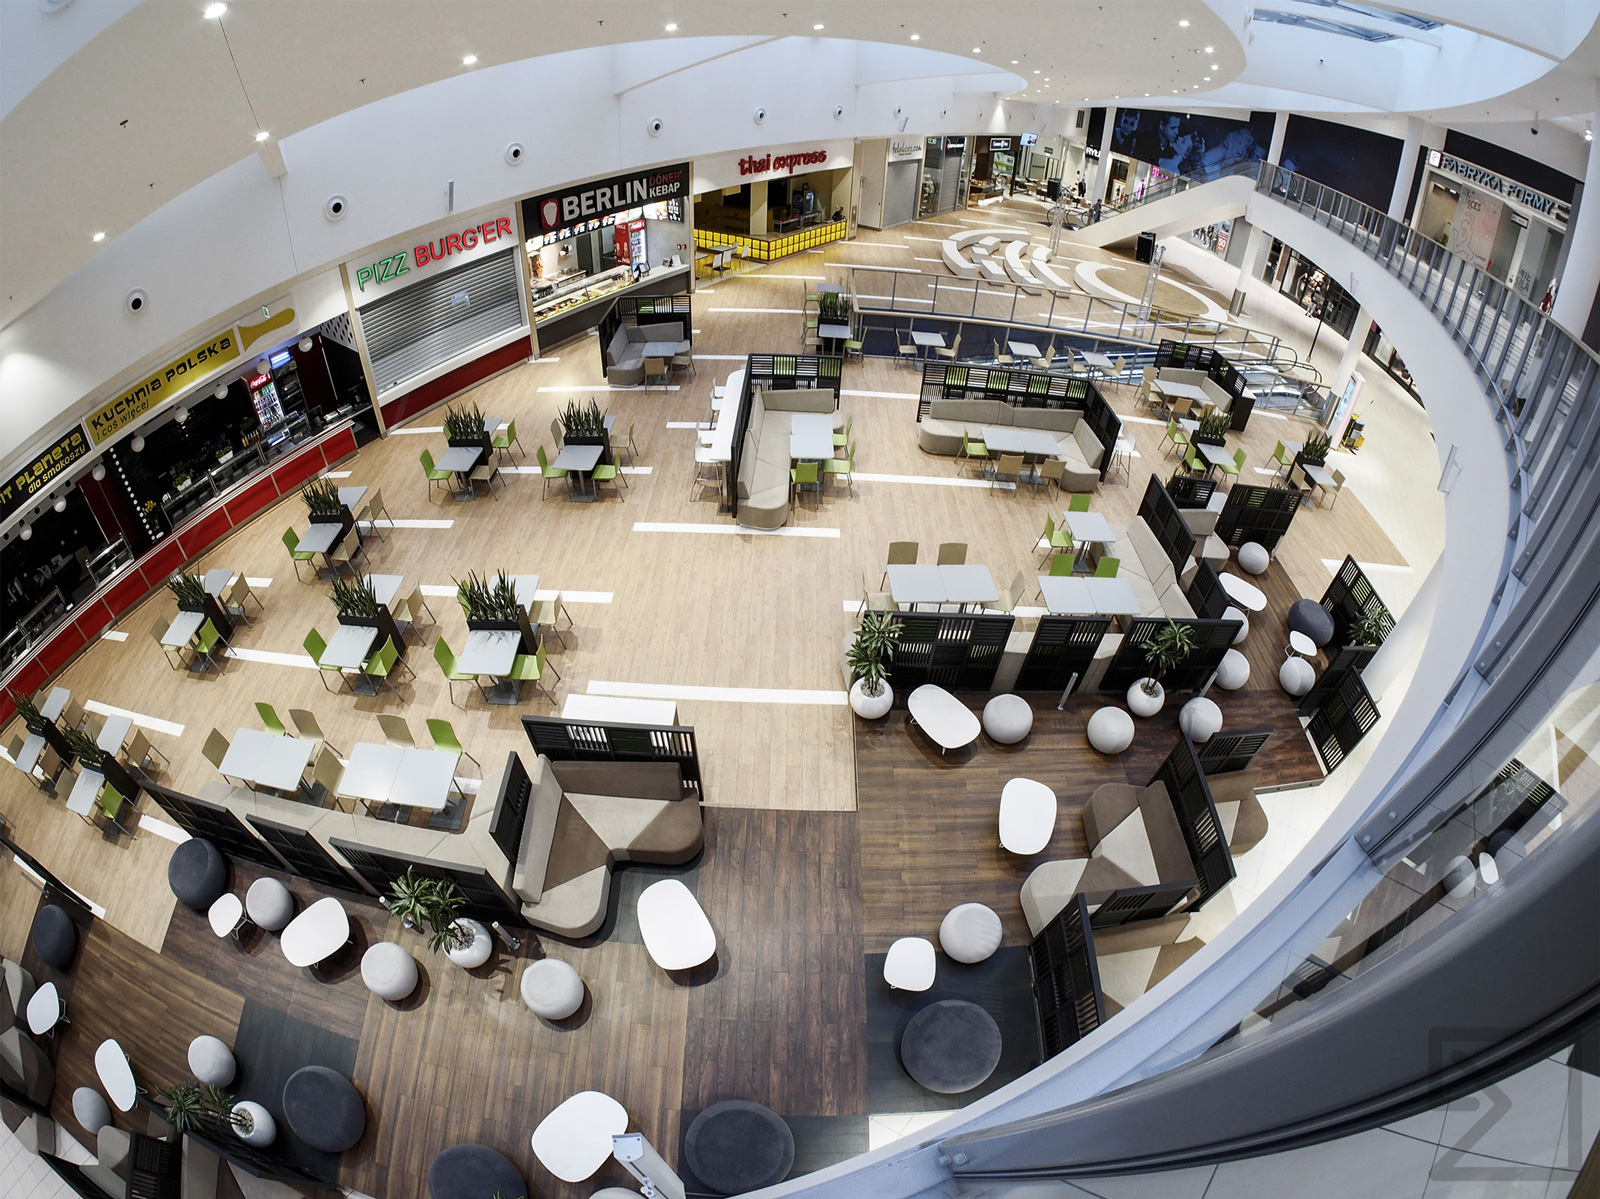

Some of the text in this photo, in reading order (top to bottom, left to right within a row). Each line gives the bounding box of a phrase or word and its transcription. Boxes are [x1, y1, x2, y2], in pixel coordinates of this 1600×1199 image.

[738, 150, 827, 175] thai express
[562, 178, 647, 221] BERLIN
[649, 182, 681, 198] KEBAP
[1441, 156, 1556, 215] FABRYKA FORMY
[357, 217, 513, 291] PIZZ BURG'ER
[28, 443, 86, 494] dla smakoszy
[0, 485, 12, 504] IT
